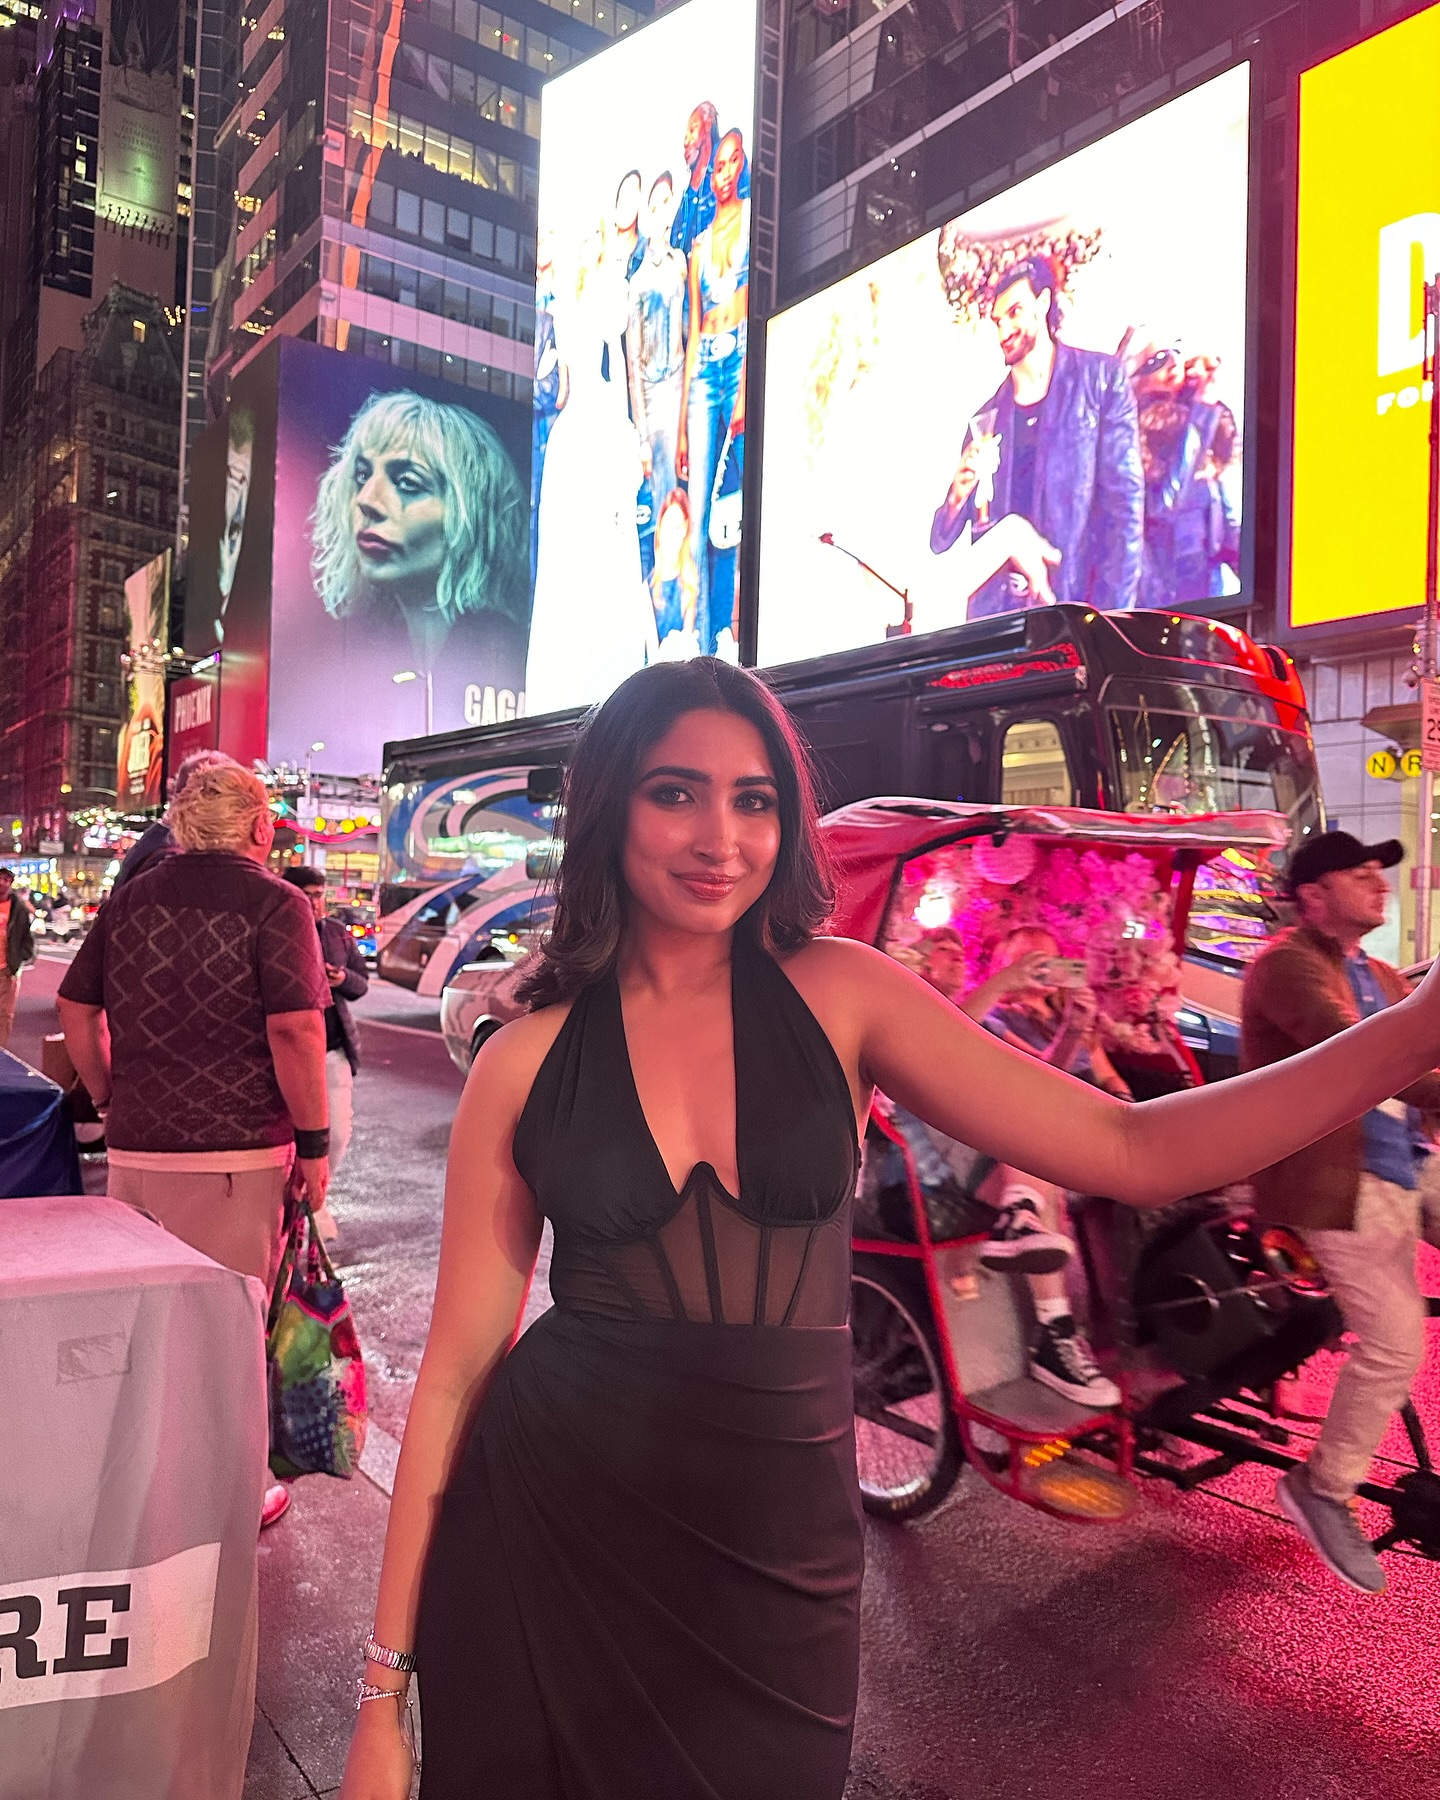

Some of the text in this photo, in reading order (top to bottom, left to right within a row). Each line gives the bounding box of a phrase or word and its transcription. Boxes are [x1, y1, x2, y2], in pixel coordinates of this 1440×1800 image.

[173, 685, 212, 734] PHOENIX
[1372, 757, 1386, 774] N
[0, 1583, 131, 1679] RE
